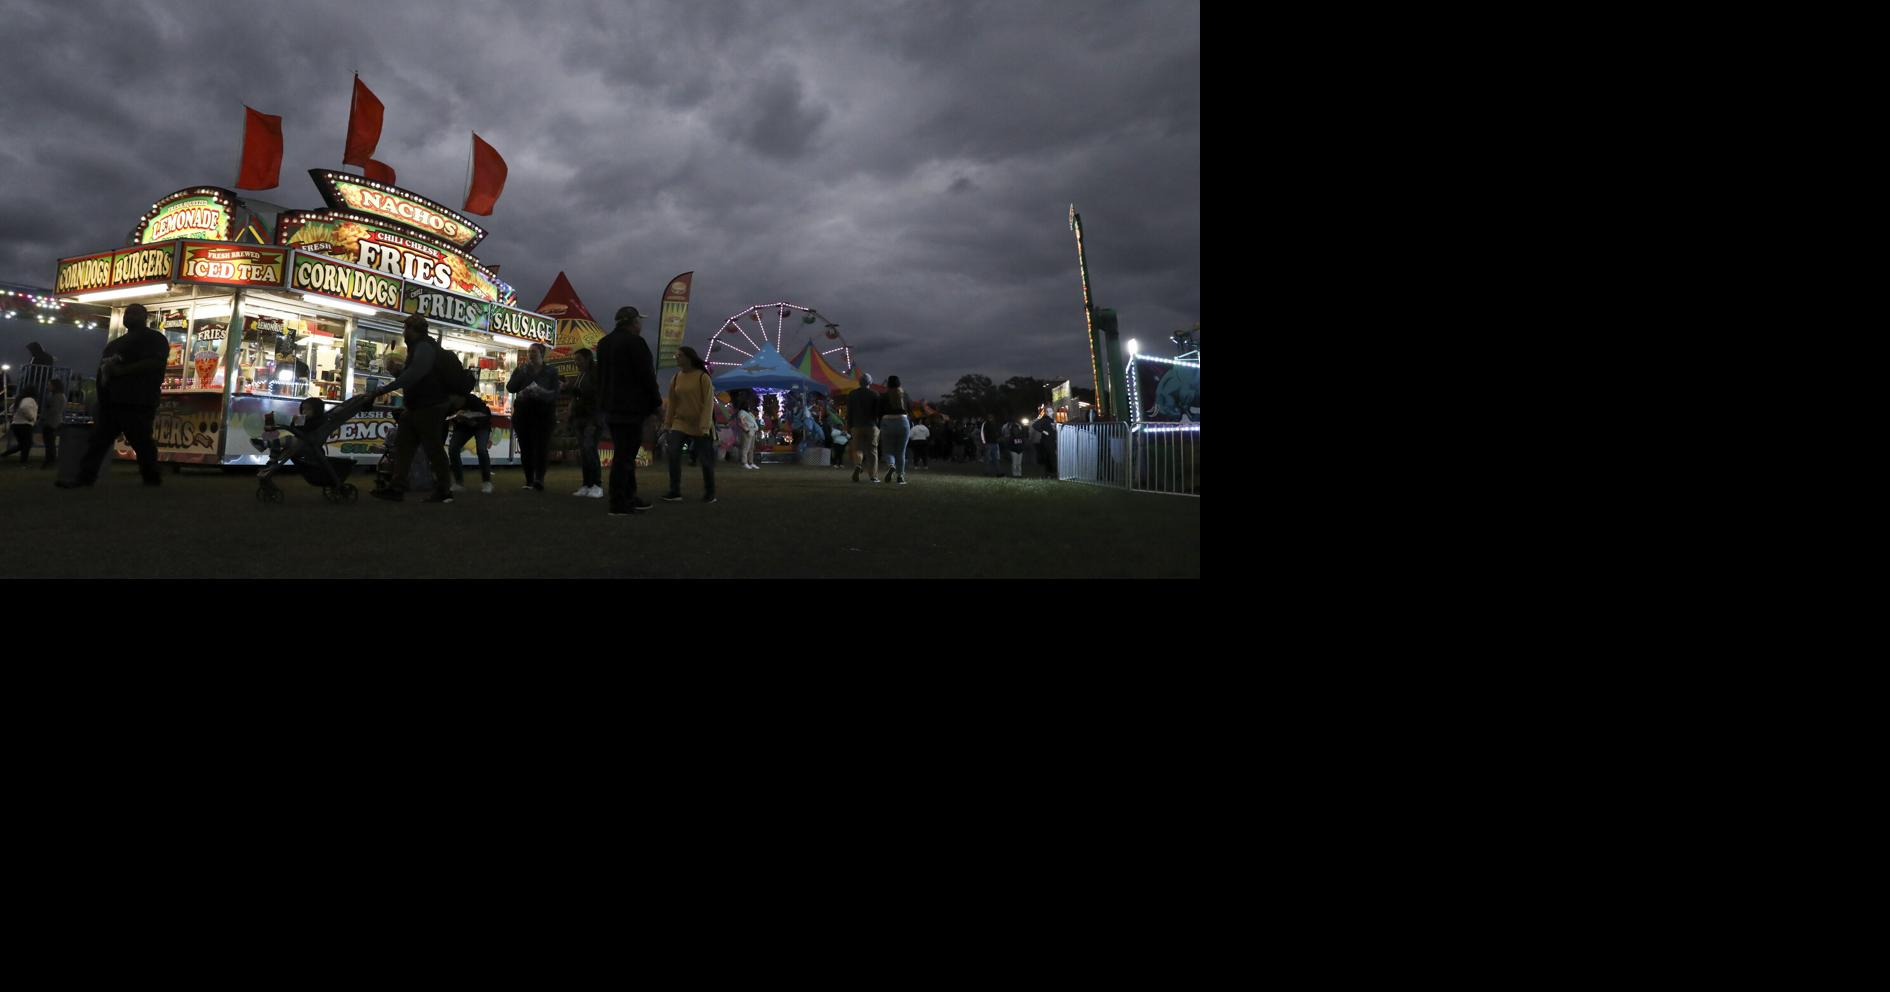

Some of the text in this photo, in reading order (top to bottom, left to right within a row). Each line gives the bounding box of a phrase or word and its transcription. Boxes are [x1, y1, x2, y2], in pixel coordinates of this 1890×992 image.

[152, 209, 219, 241] LEMONADE
[360, 191, 458, 238] NACHOS
[208, 250, 260, 259] FRESH BREWED
[301, 242, 332, 251] FRESH
[377, 232, 439, 257] CHILI CHEESE
[60, 259, 109, 291] CORN DOGS
[114, 249, 170, 283] BURGERS
[187, 260, 277, 282] ICED TEA
[356, 239, 452, 290] FRIES
[297, 262, 399, 307] CORN DOGS
[416, 293, 478, 325] FRIES
[198, 328, 227, 341] FRIES
[493, 312, 554, 342] SAUSAGE
[351, 411, 384, 419] RESH
[325, 421, 399, 443] LEMO
